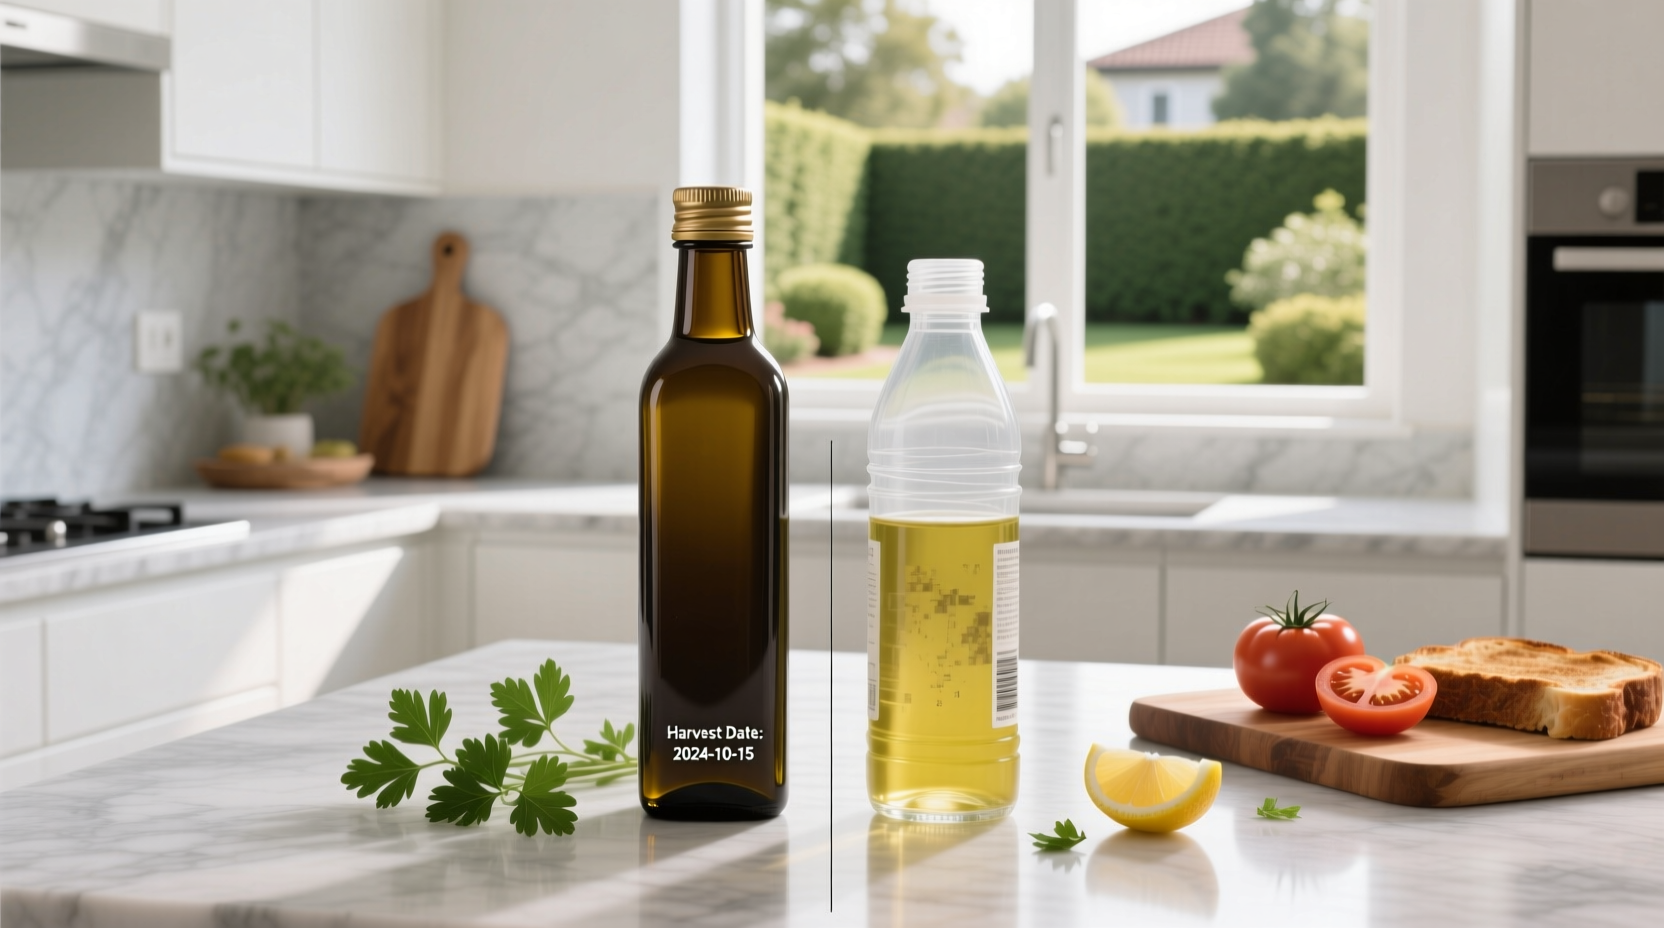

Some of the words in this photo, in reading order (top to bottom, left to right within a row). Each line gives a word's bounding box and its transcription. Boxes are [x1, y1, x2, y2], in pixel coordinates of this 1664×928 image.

[667, 725, 722, 740] Harvest
[725, 725, 764, 740] Date:
[672, 746, 755, 761] 2024-10-15
